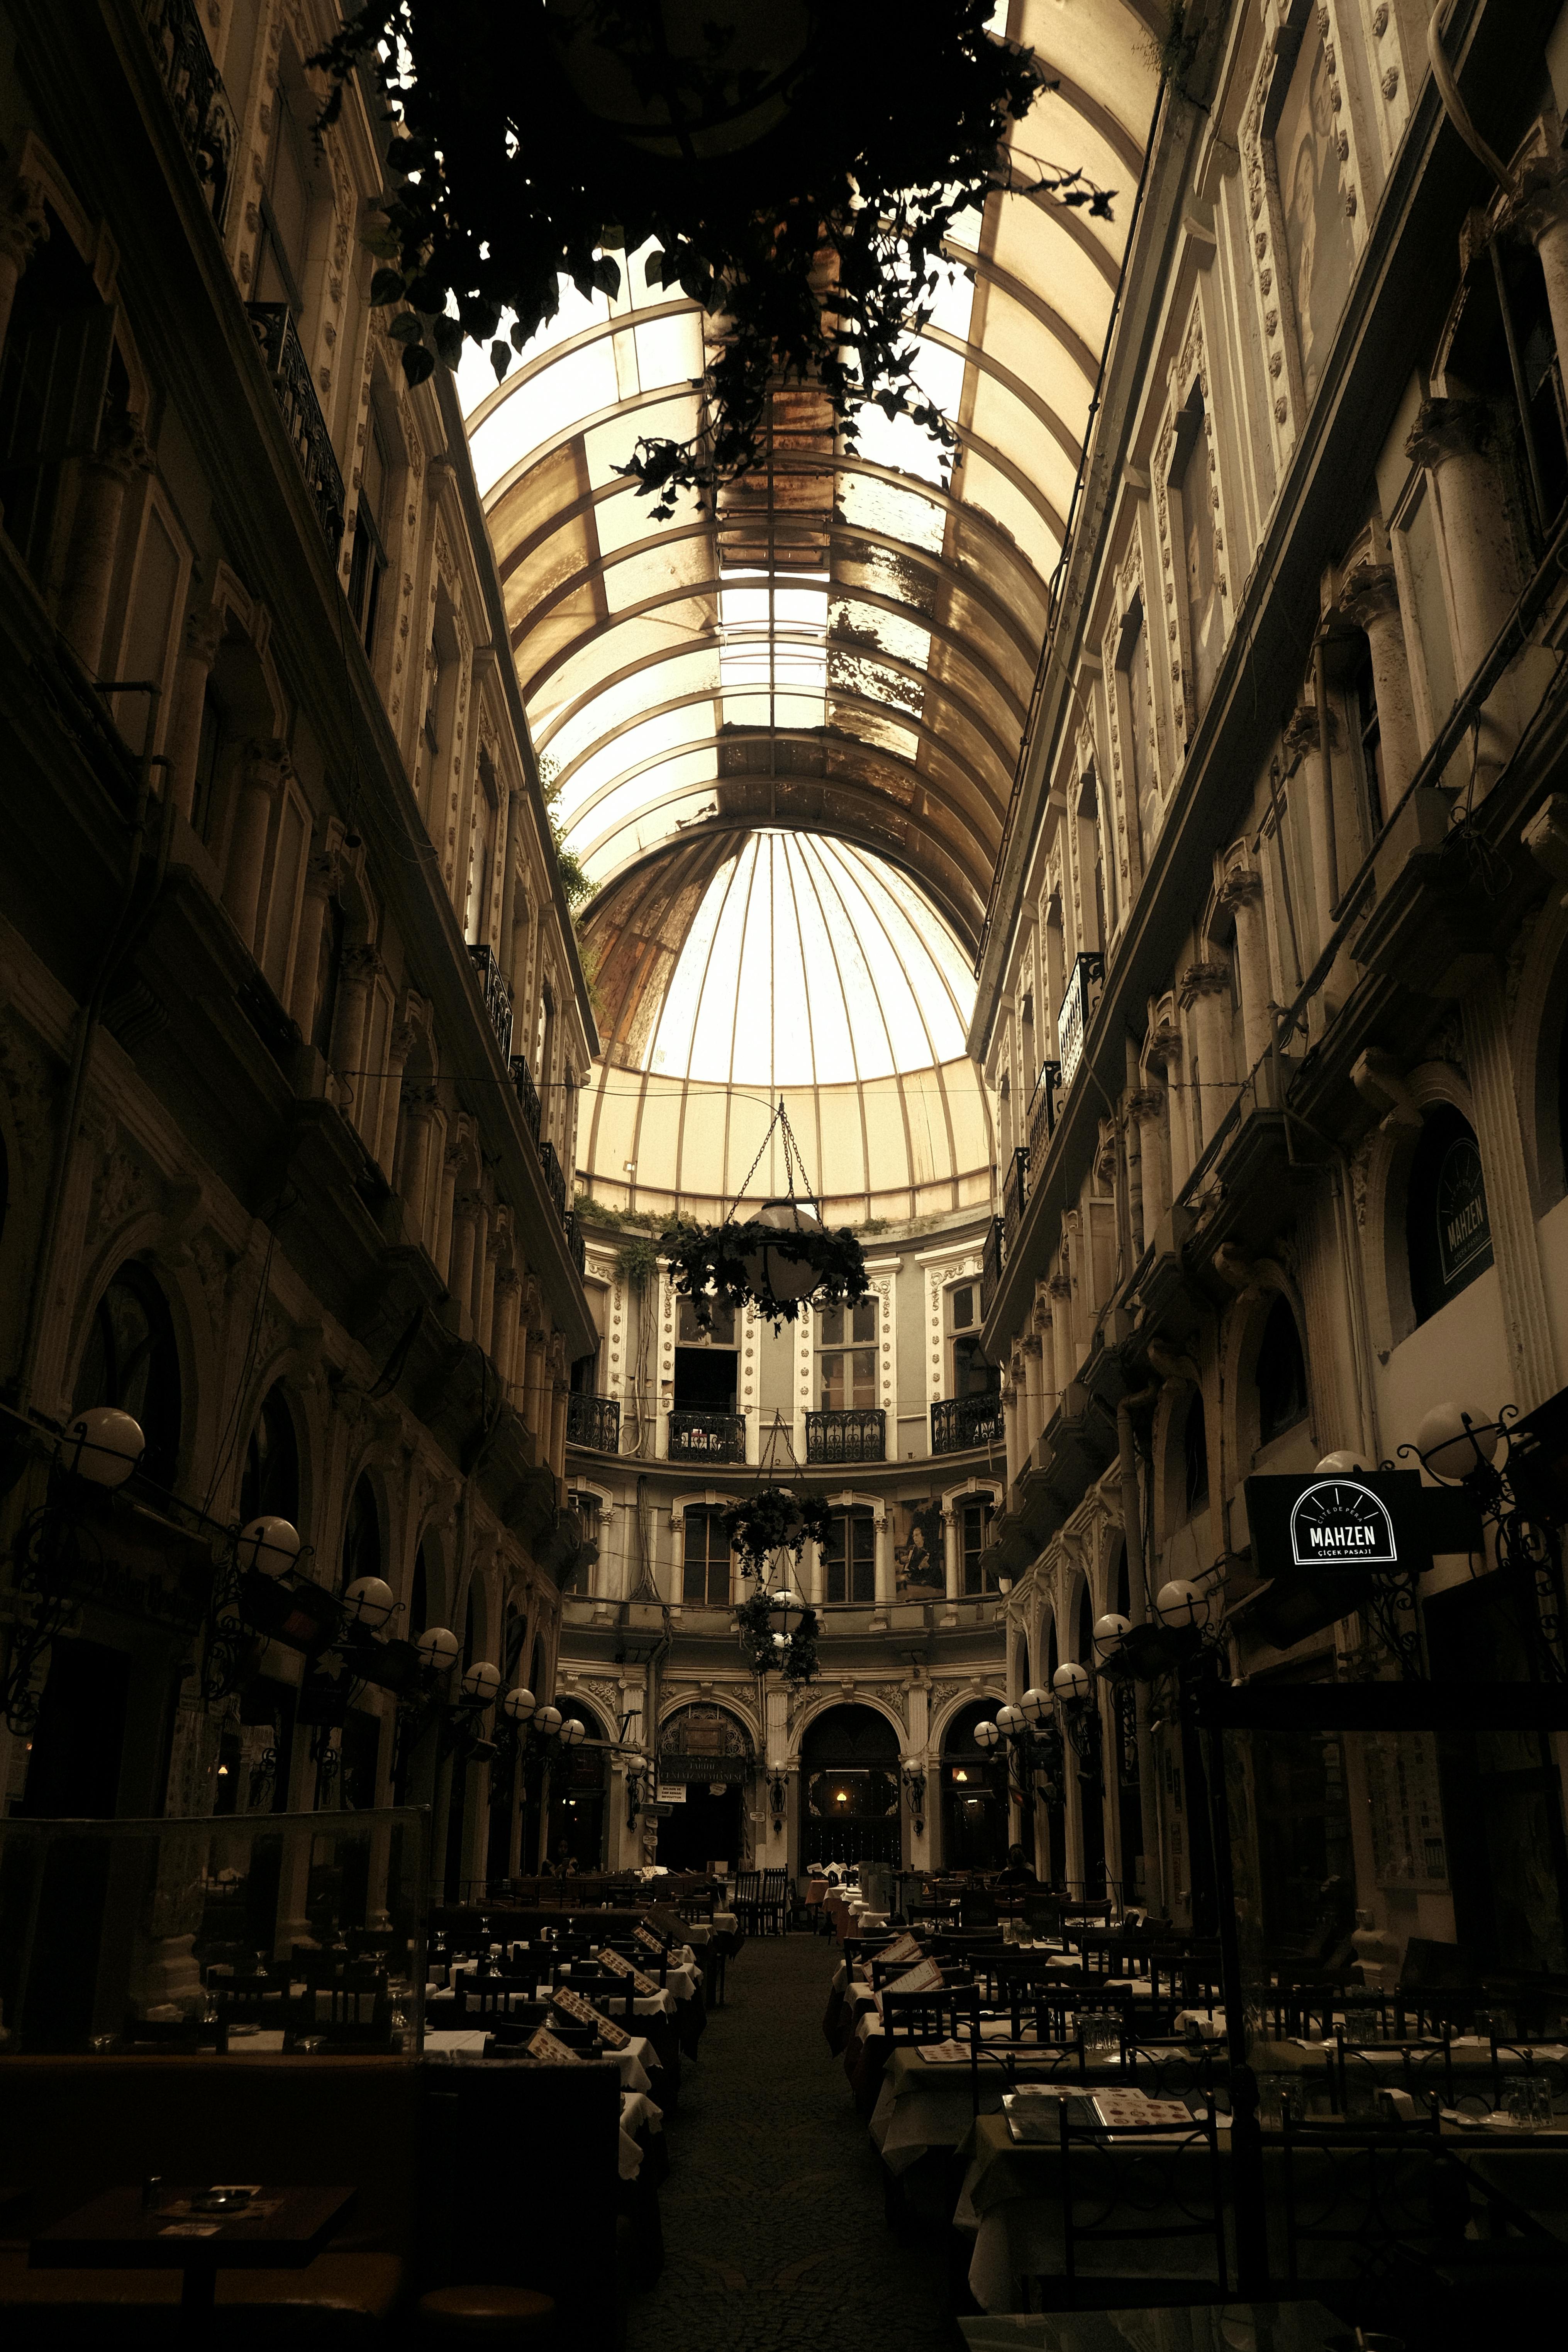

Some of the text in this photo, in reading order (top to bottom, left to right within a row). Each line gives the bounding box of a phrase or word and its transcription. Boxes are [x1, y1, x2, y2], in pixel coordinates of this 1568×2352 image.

[1448, 1195, 1483, 1252] MAHZEN
[1317, 1509, 1332, 1524] CITE
[1345, 1507, 1363, 1522] PERA
[1310, 1526, 1375, 1547] MAHZEN
